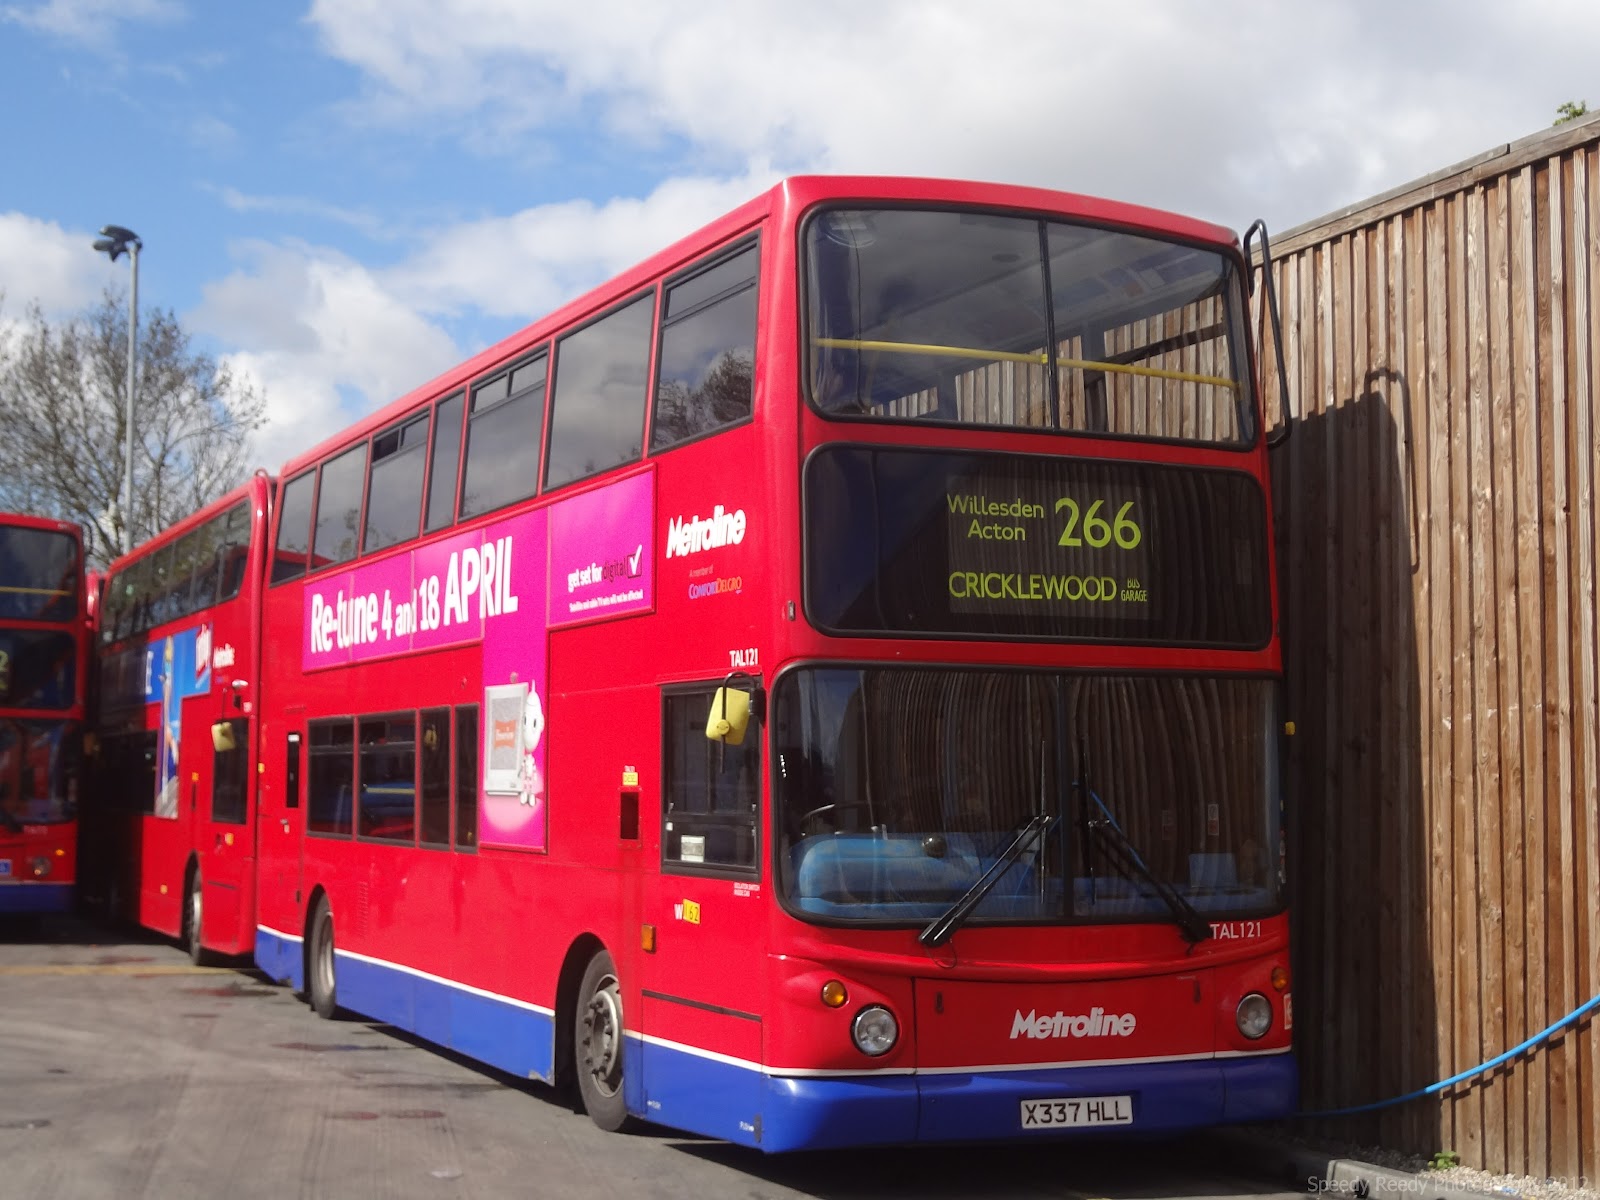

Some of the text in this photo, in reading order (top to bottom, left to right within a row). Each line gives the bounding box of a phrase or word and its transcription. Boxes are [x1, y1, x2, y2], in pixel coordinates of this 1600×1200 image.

[947, 493, 1044, 519] Willesden
[666, 504, 746, 559] Metroline
[967, 519, 1026, 541] Acton
[1055, 497, 1142, 550] 266
[311, 590, 379, 654] Re-tune
[381, 589, 393, 641] 4
[395, 588, 418, 637] and
[419, 575, 441, 631] 18
[443, 535, 518, 626] APRIL
[948, 571, 1117, 601] CRICKLEWOOD
[1121, 590, 1148, 602] GARAGE
[729, 648, 759, 668] TAL121
[1210, 921, 1262, 940] TAL121
[1009, 1007, 1137, 1040] Metroline
[1025, 1101, 1129, 1125] X337 HLL
